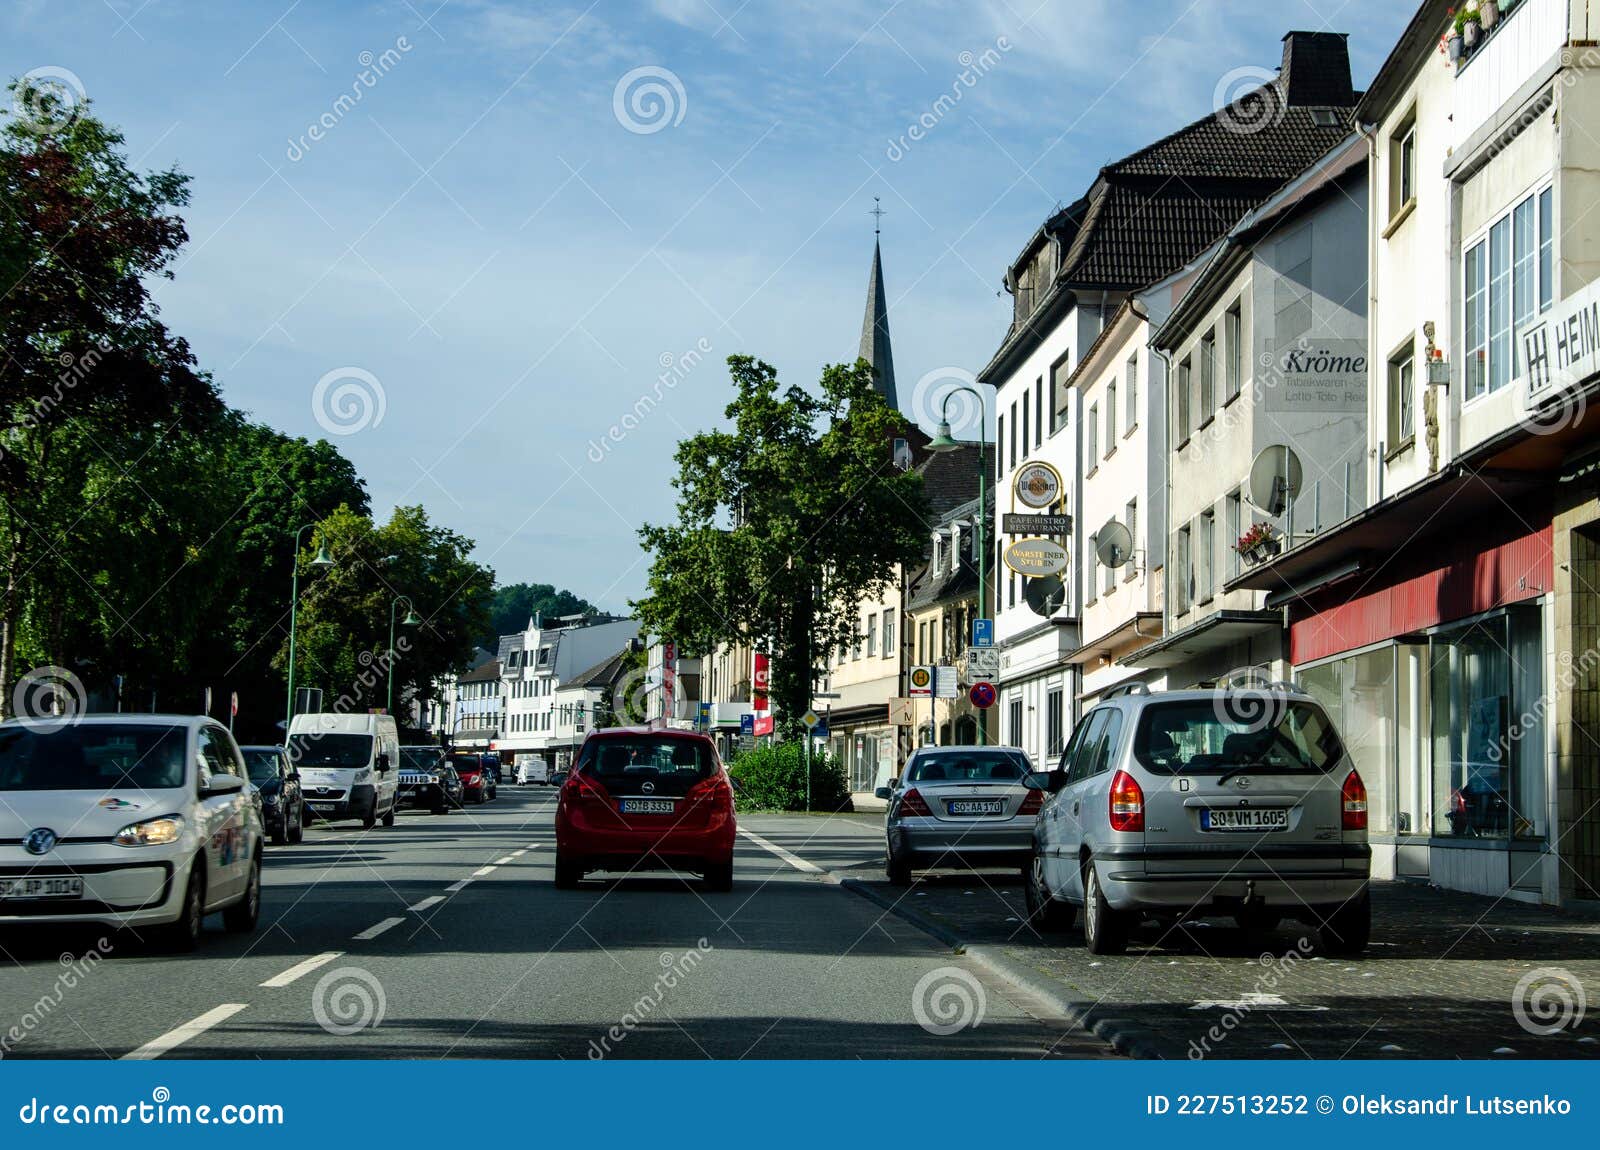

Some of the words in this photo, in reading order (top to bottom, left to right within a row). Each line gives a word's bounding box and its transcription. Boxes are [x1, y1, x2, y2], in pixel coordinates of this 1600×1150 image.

[976, 621, 985, 634] P
[742, 715, 749, 724] P
[1179, 779, 1190, 792] D
[1254, 810, 1286, 825] 1605
